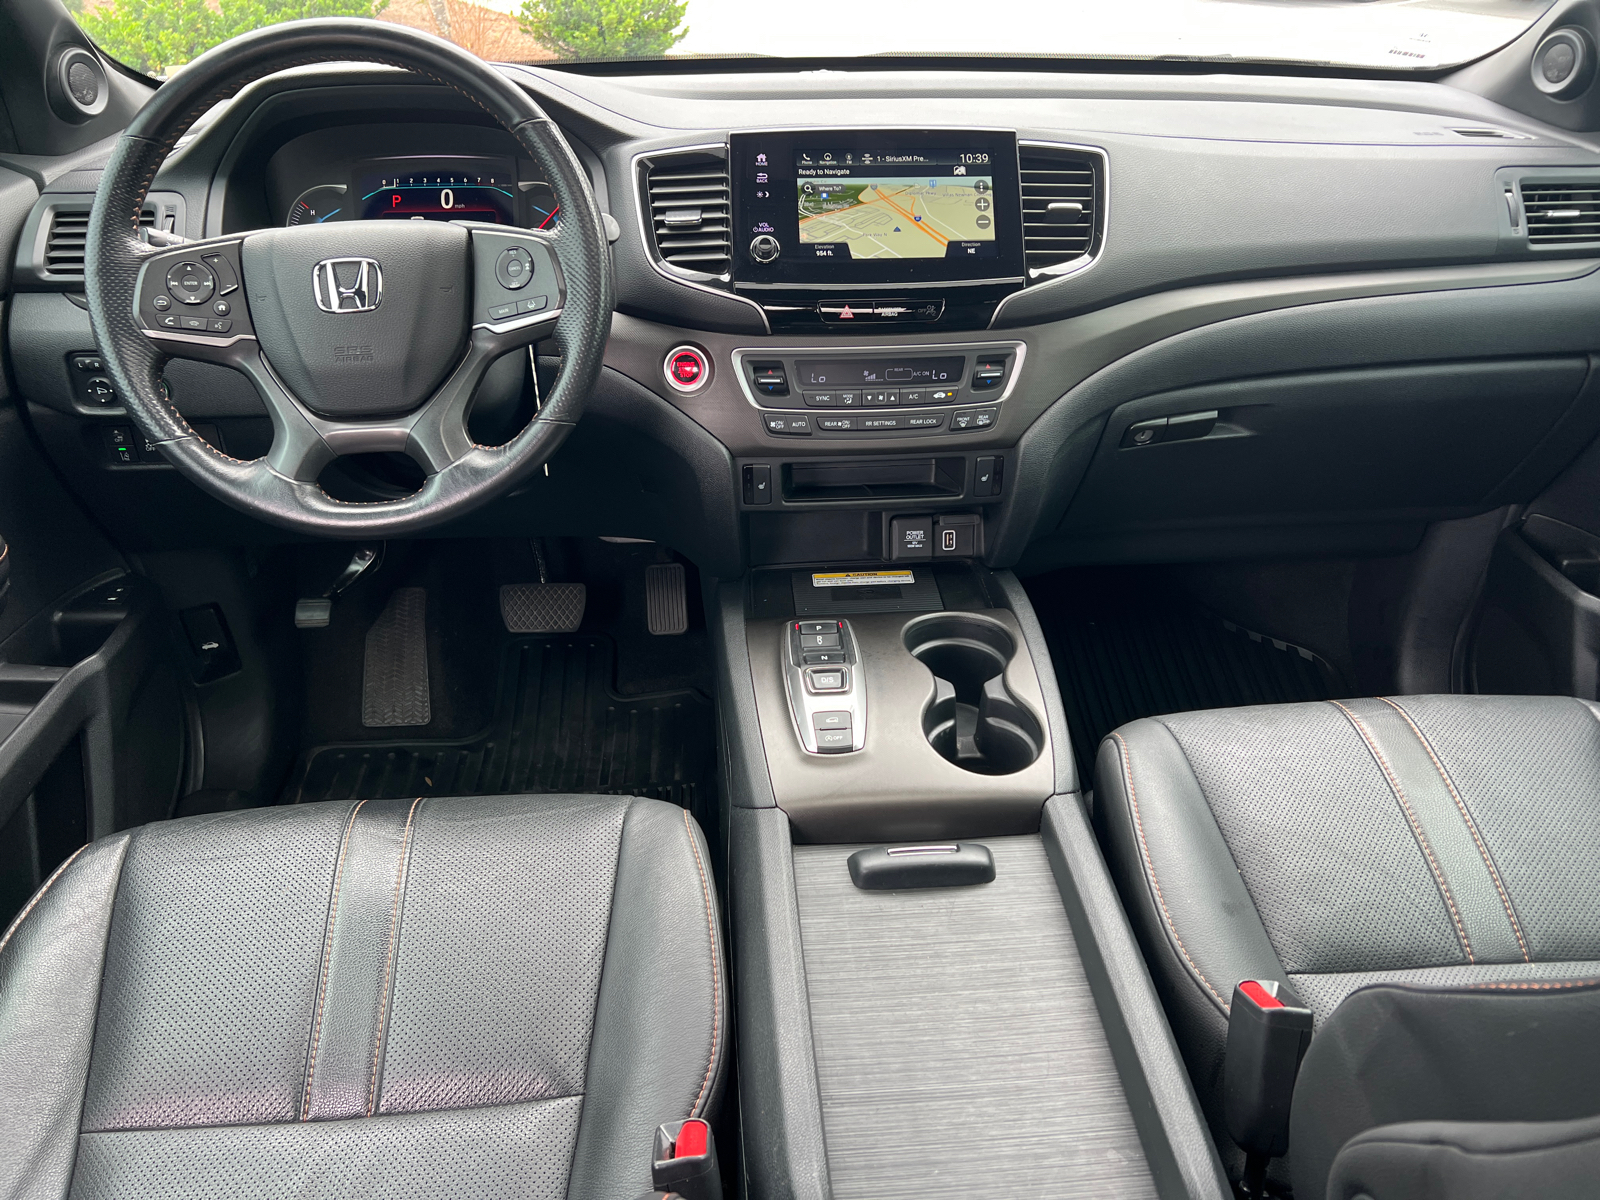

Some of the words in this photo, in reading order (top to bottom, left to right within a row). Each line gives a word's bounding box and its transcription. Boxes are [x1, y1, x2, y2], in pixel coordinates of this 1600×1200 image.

[960, 154, 988, 163] 10:39
[392, 195, 401, 207] P
[440, 189, 454, 209] 0
[334, 346, 373, 354] SRS
[811, 373, 826, 383] Lo
[932, 370, 947, 380] Lo
